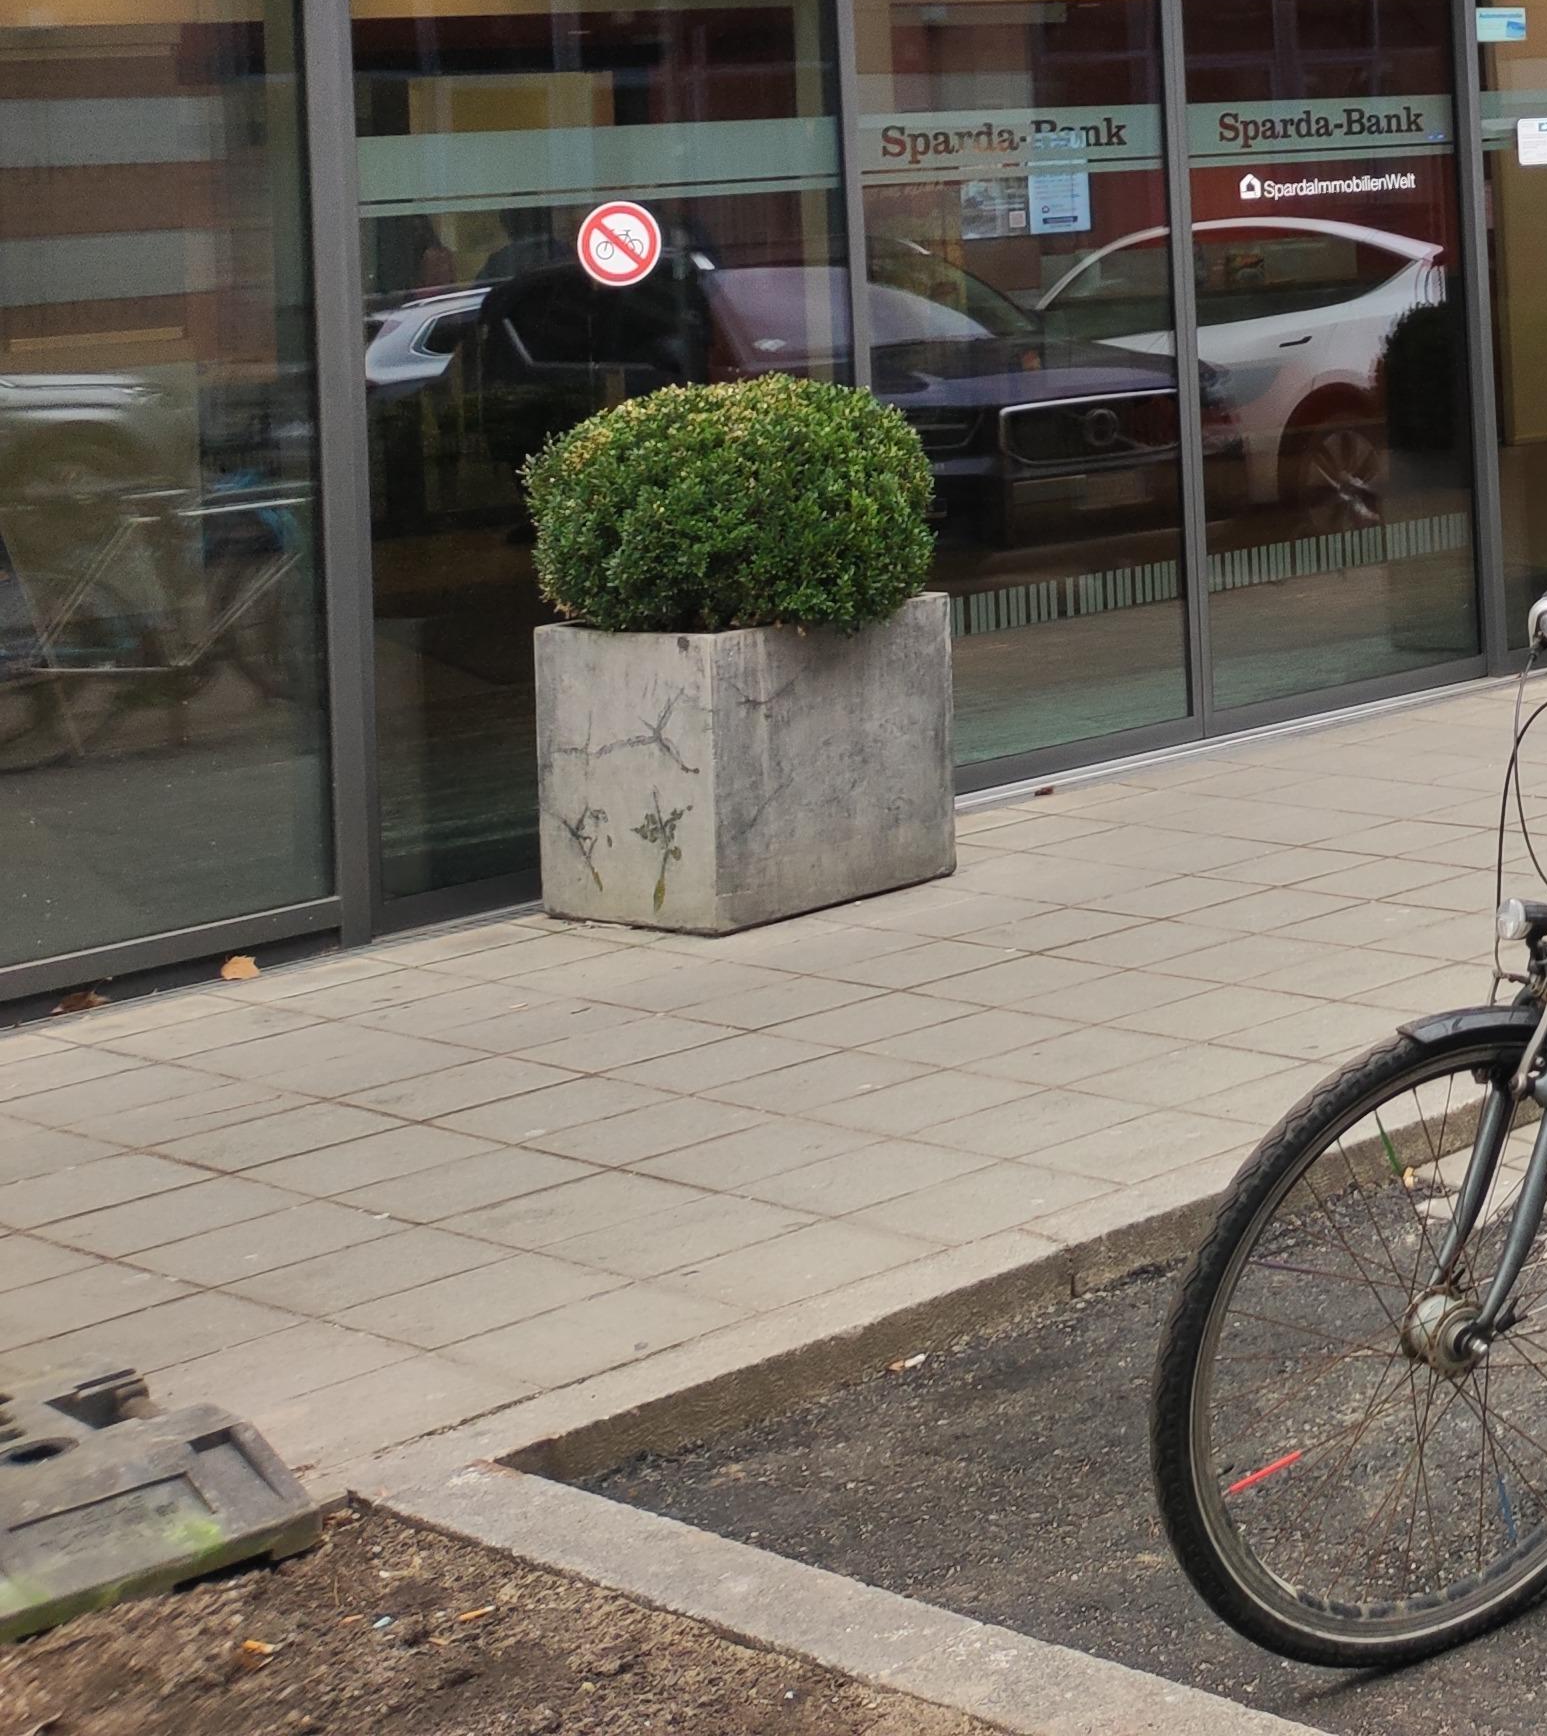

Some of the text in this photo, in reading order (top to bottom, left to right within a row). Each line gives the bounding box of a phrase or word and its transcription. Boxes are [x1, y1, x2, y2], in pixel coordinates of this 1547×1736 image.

[881, 117, 1127, 164] Sparda-Bnk
[1218, 106, 1425, 149] Sparda-Bank
[1263, 172, 1416, 198] SpardaImmobilienWelt
